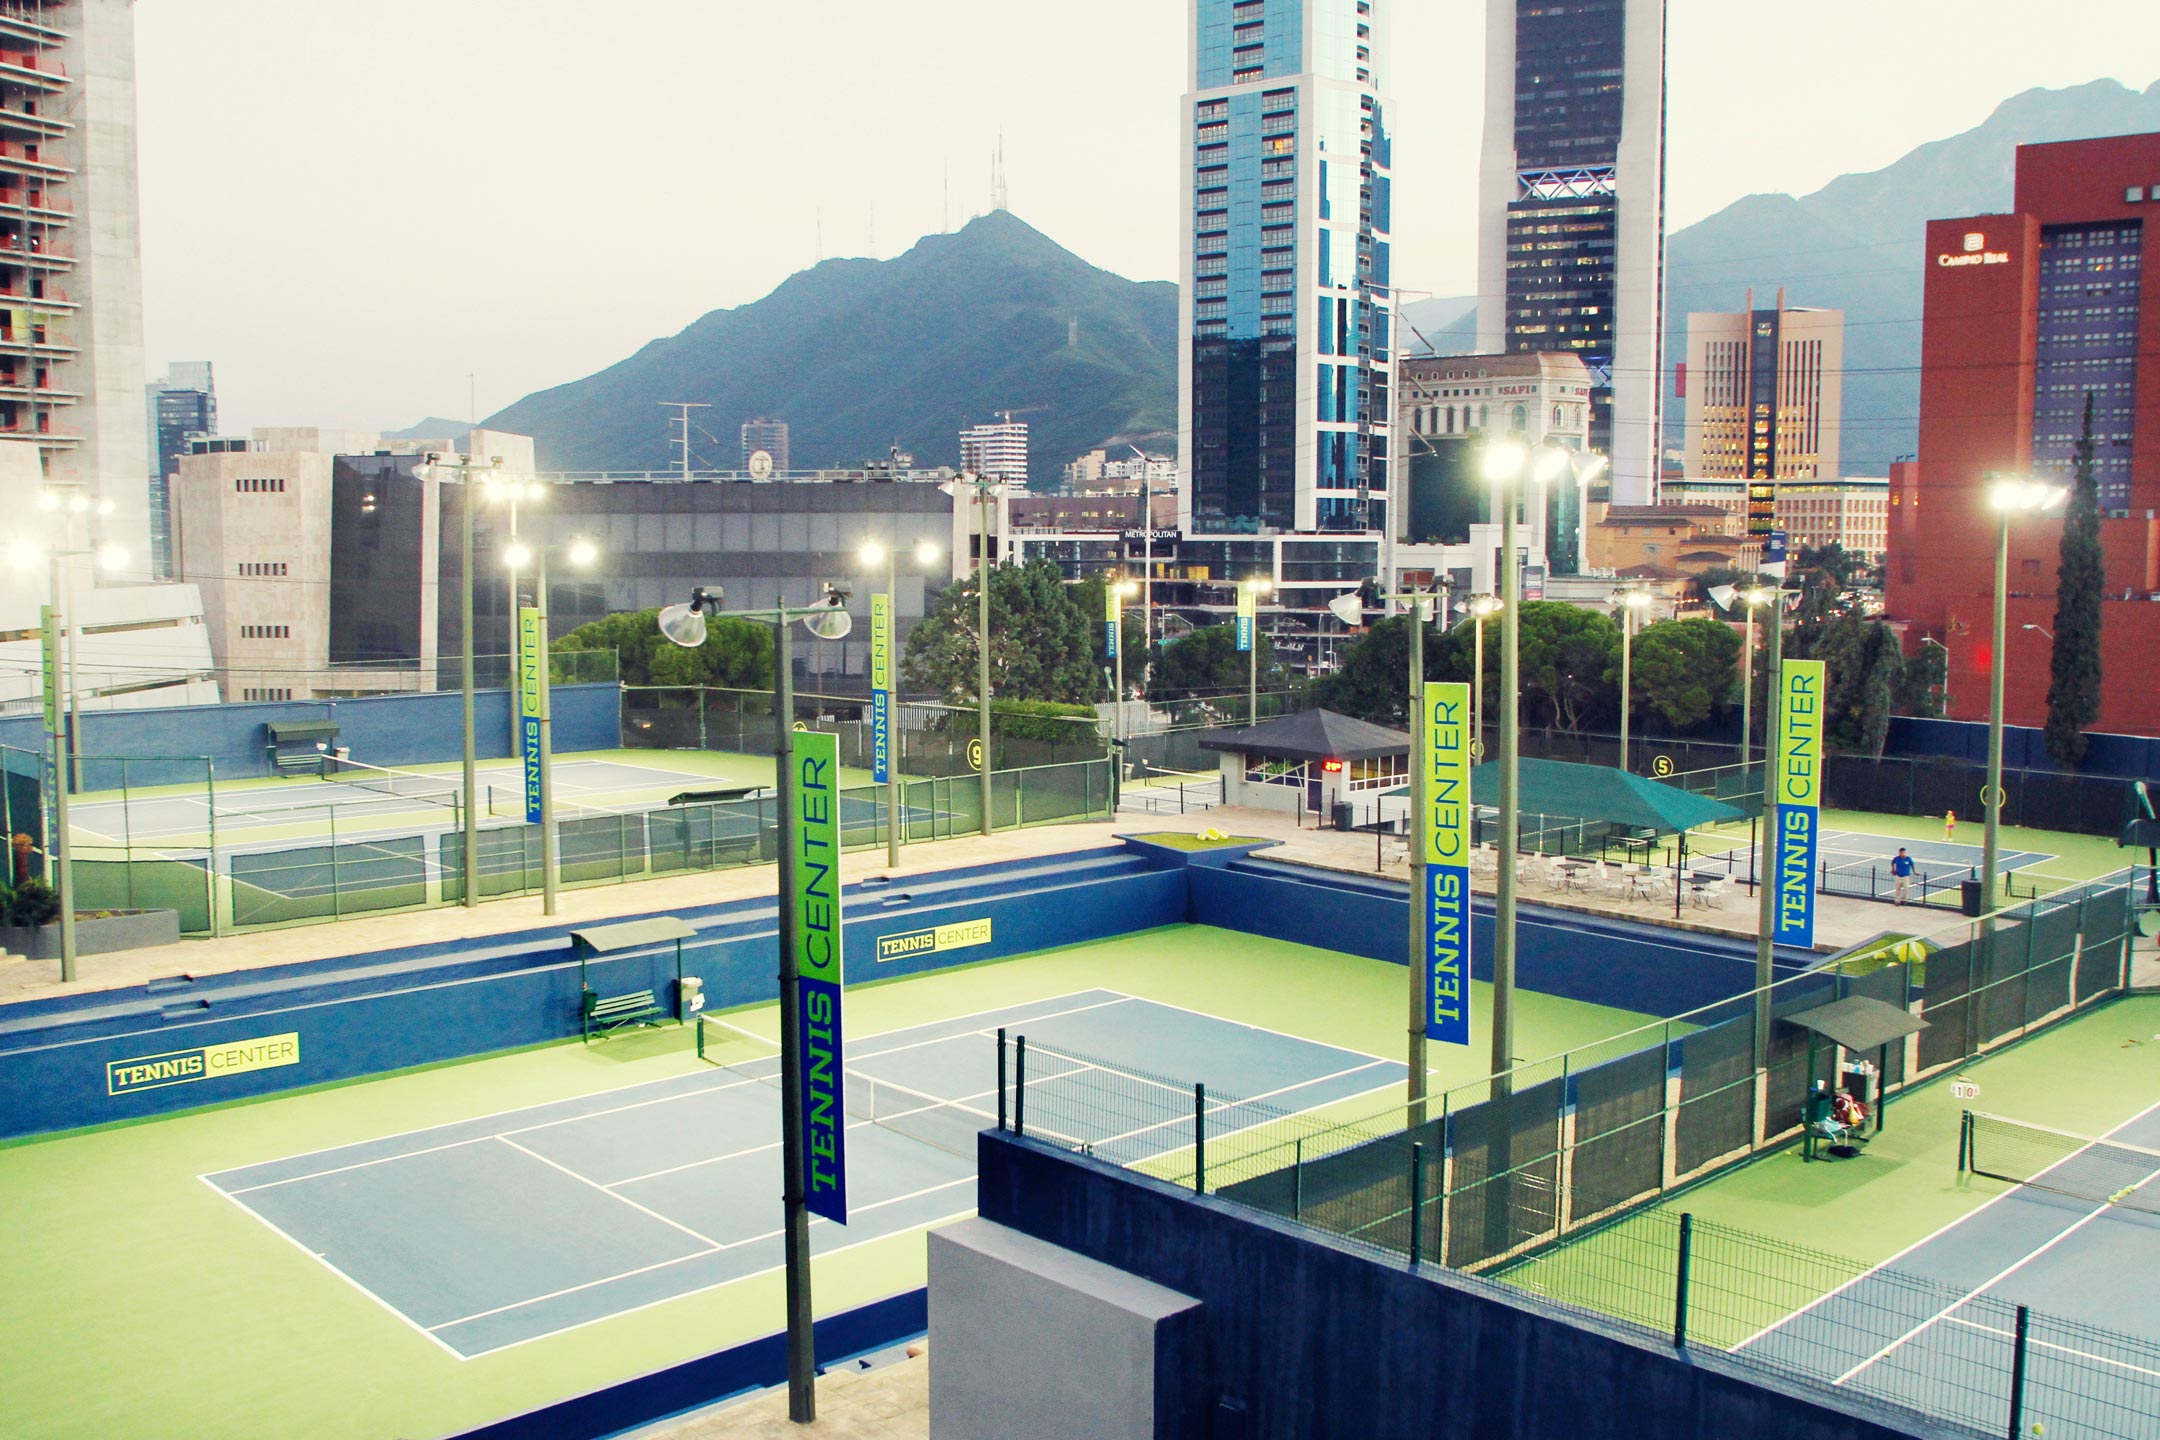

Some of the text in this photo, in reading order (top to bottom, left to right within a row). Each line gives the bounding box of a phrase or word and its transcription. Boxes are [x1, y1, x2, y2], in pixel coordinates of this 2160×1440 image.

[1503, 385, 1530, 395] SAFI
[1240, 618, 1248, 650] TENNIS
[875, 603, 886, 774] TENNIS CENTER
[524, 618, 541, 813] TENNIS CENTER
[972, 745, 982, 765] 9
[1658, 760, 1668, 774] 5
[1781, 674, 1814, 932] TENNIS CENTER
[1434, 701, 1461, 1025] TENNIS CENTER
[881, 925, 989, 955] TENNIS CENTER
[802, 756, 836, 1193] TENNIS CENTER
[114, 1041, 294, 1087] TENNIS CENTER
